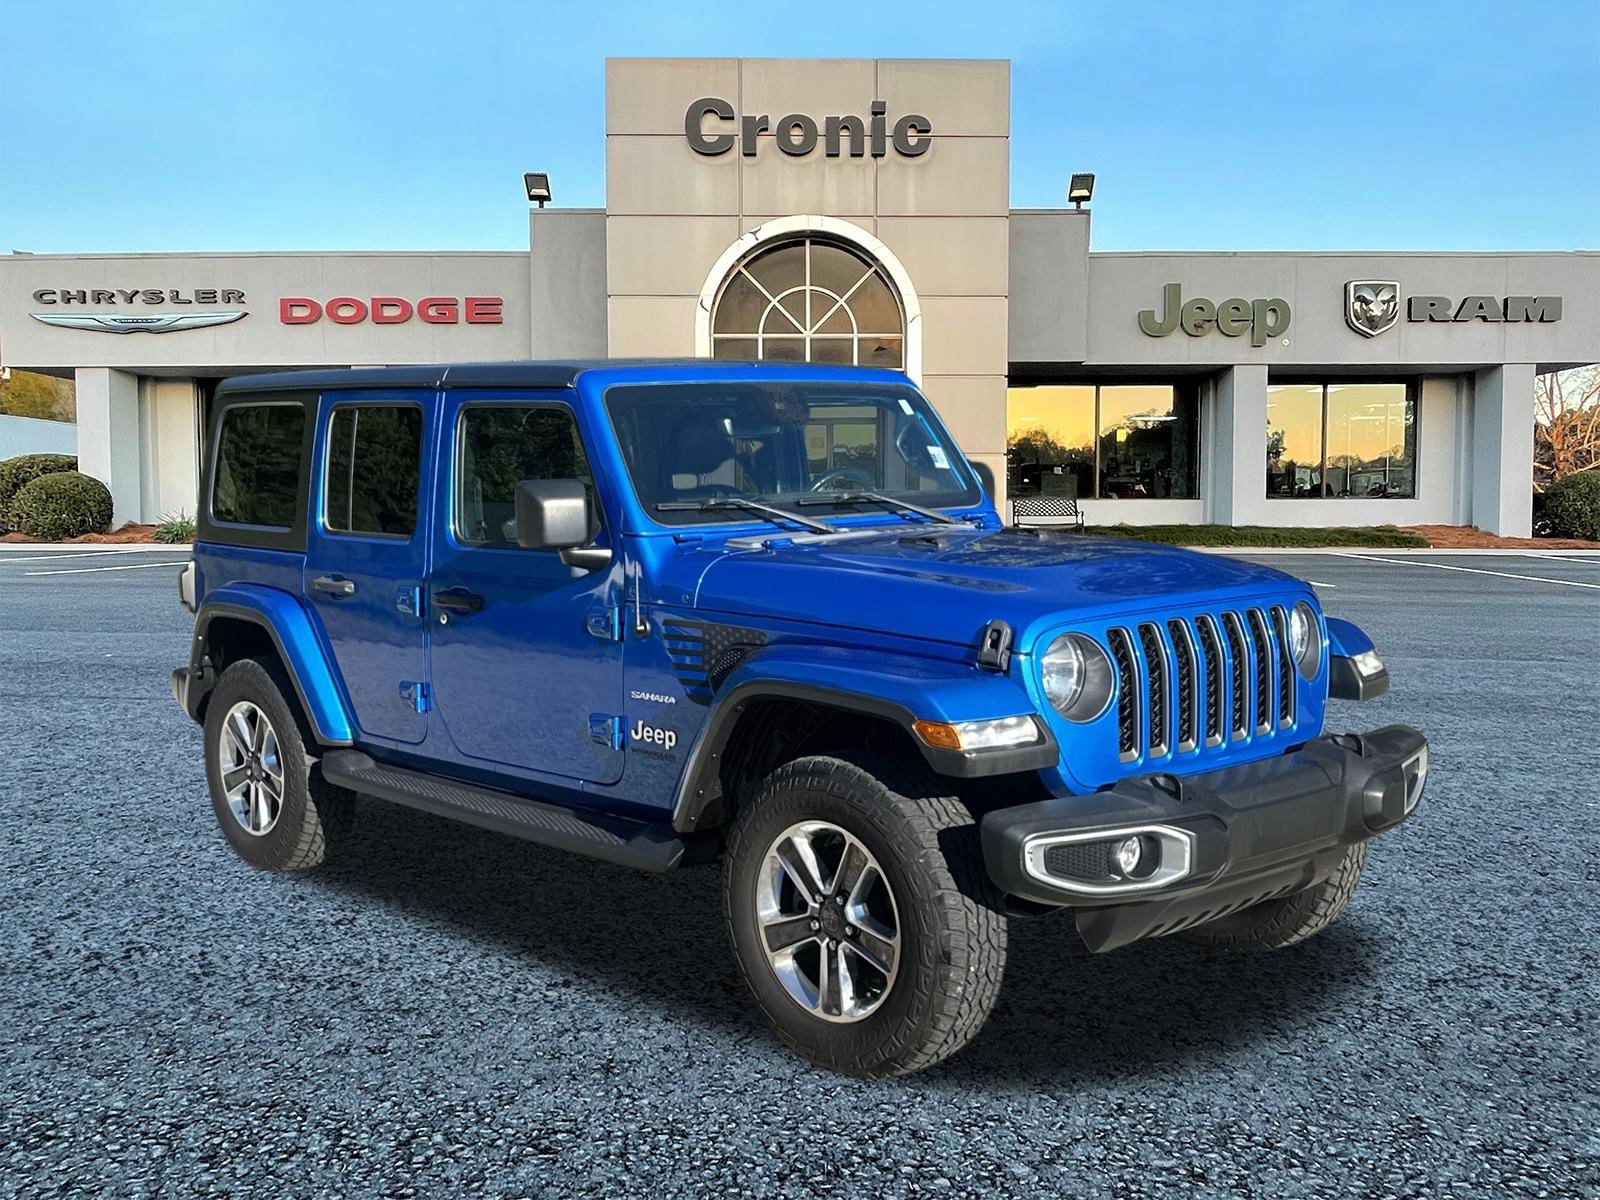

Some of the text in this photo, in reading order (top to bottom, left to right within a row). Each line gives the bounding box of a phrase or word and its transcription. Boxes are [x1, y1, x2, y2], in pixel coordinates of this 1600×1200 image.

[685, 97, 932, 157] Cronic
[32, 289, 246, 304] CHRYSLER
[1408, 296, 1562, 322] RAM
[279, 297, 503, 324] DODGE
[1138, 283, 1291, 347] Jeep
[631, 691, 676, 704] SAHARA
[631, 719, 677, 750] Jeep
